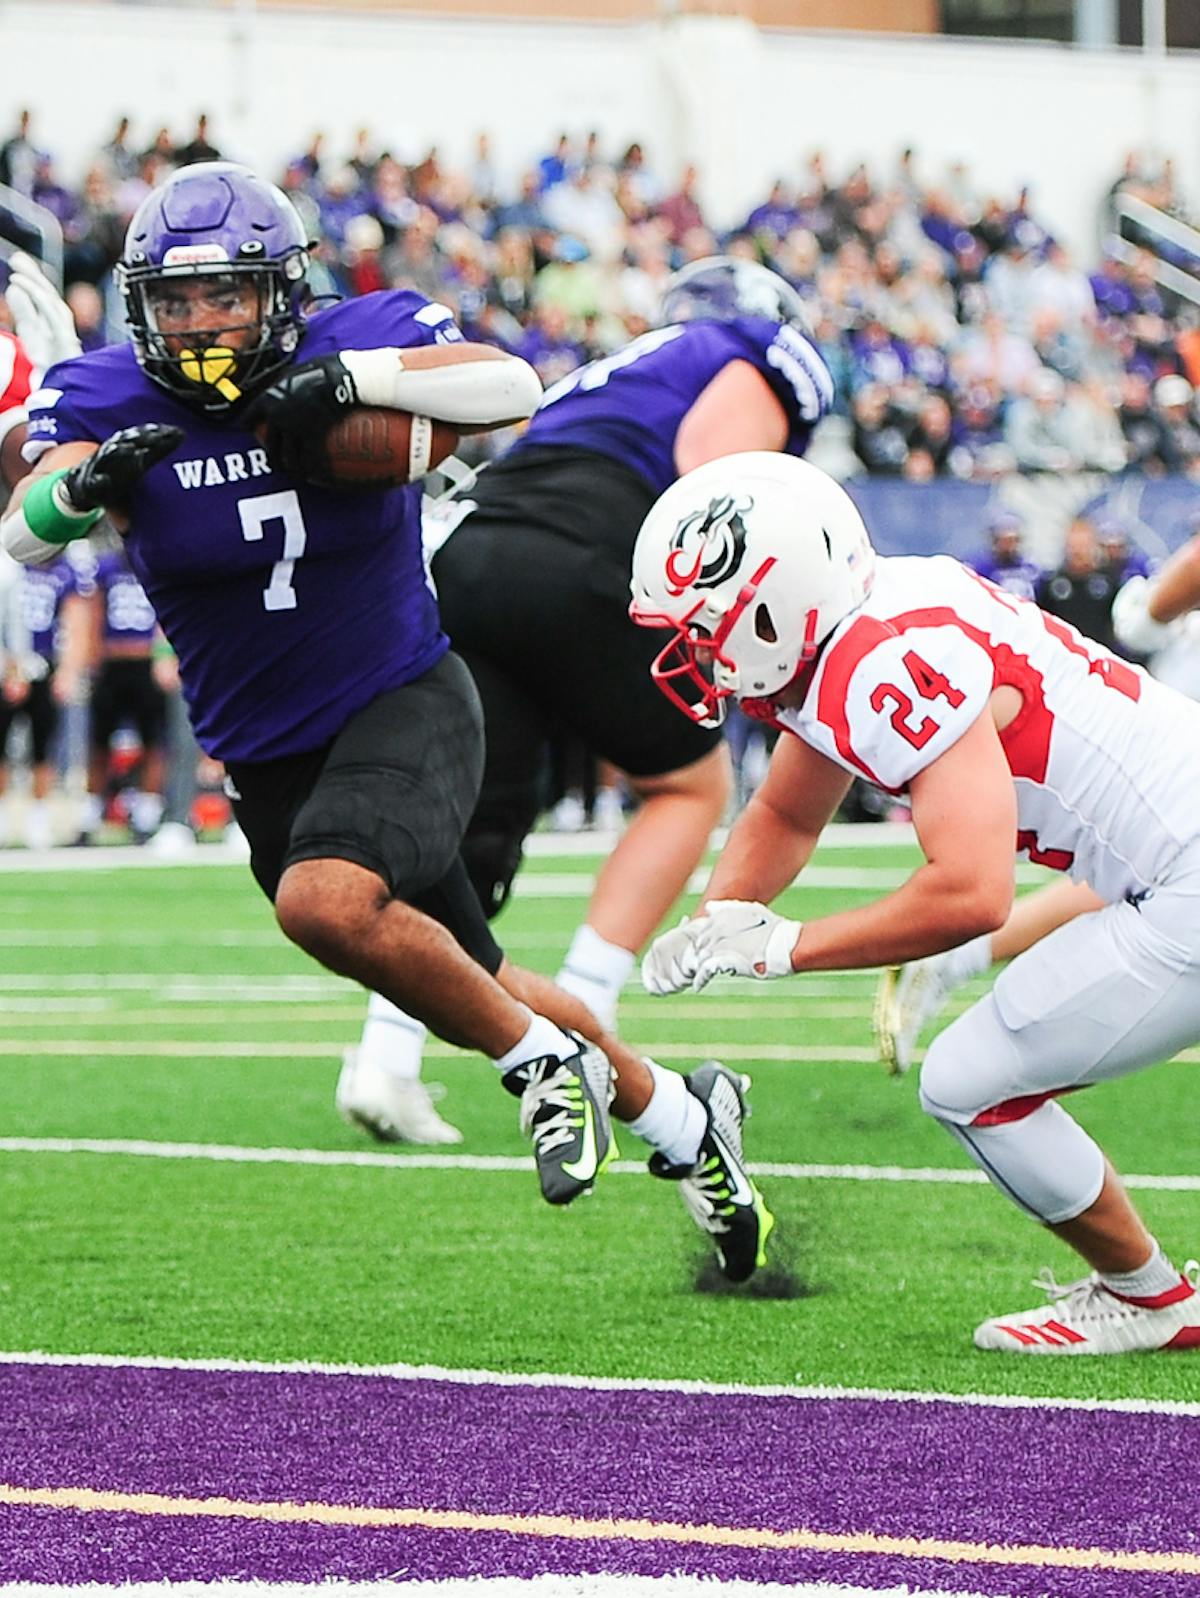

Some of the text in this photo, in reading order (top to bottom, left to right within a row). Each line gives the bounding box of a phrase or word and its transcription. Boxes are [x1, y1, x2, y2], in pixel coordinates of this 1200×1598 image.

[172, 447, 272, 489] WARR
[237, 489, 307, 611] 7
[869, 649, 967, 751] 24
